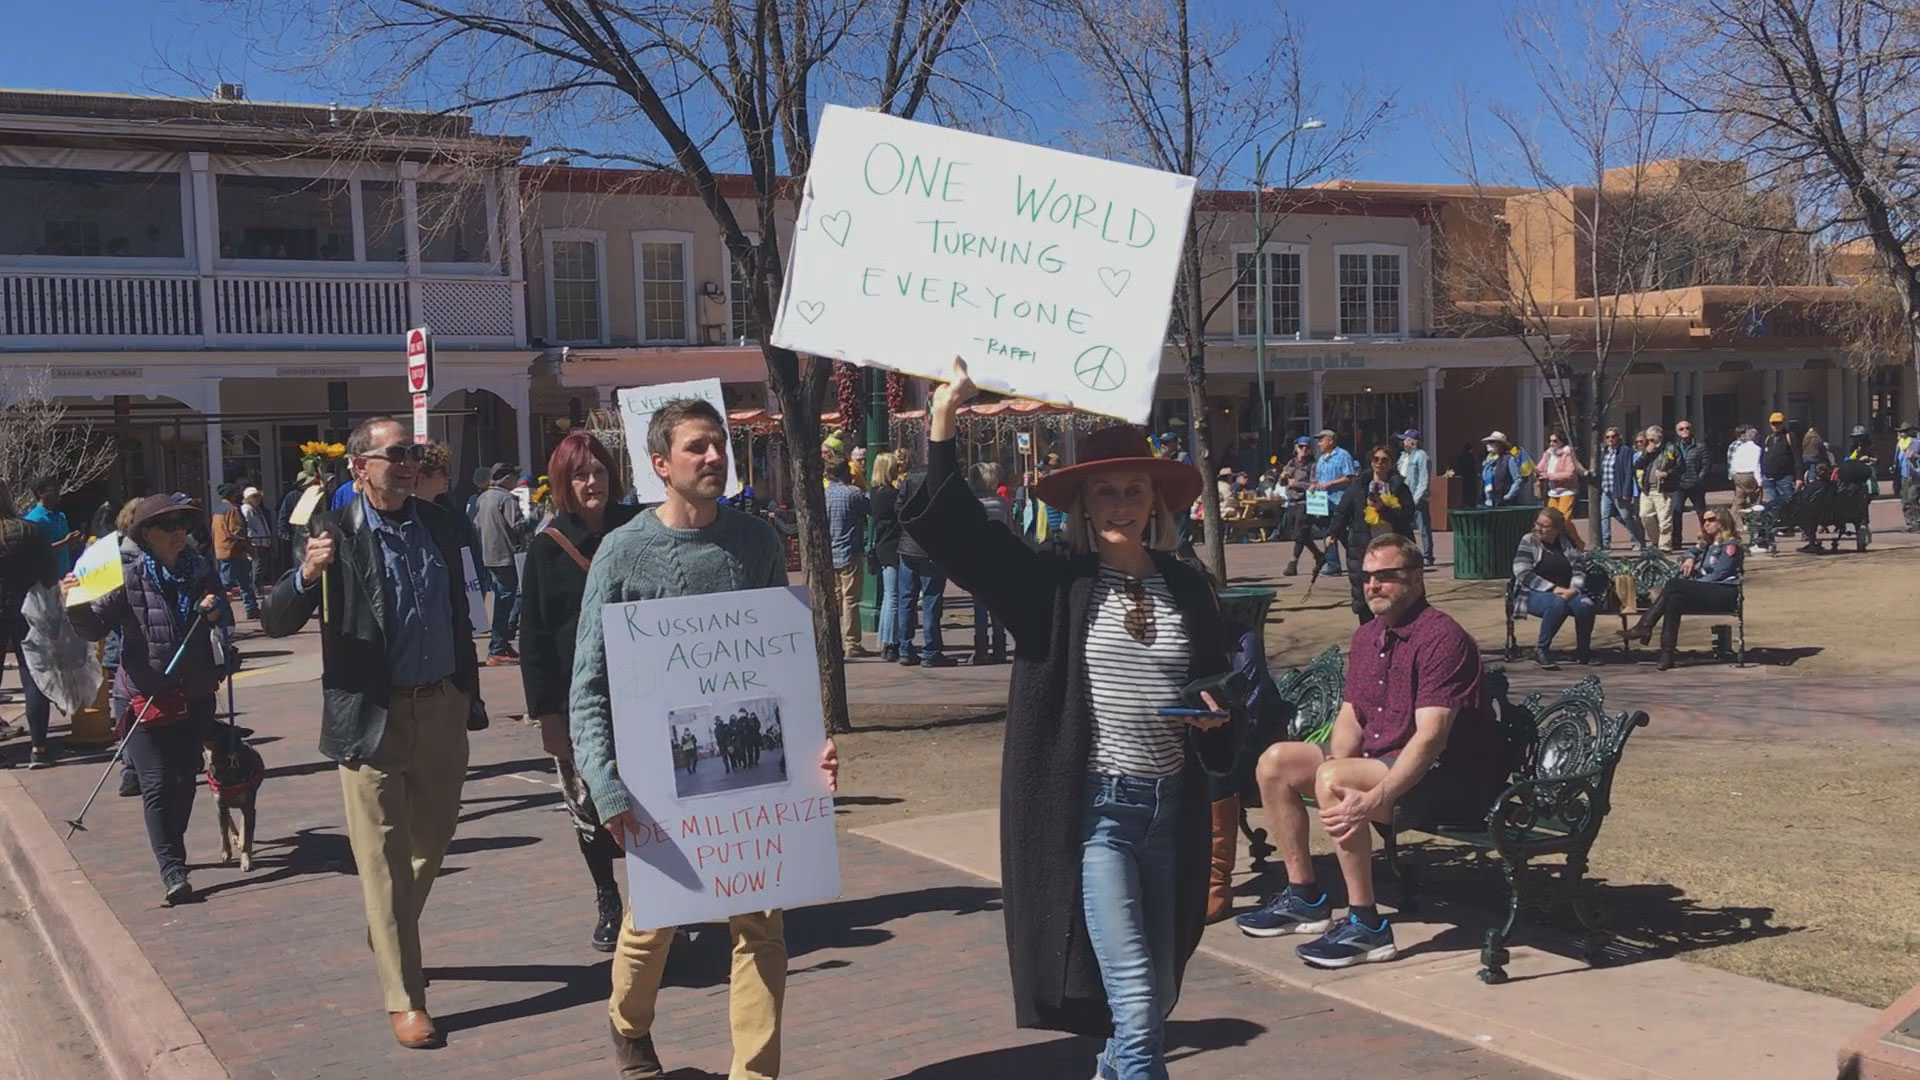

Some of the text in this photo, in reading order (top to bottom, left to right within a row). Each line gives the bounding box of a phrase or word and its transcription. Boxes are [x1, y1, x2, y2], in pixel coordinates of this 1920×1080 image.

[863, 142, 1155, 249] ONE WORLD
[915, 219, 1067, 274] TURNING
[862, 267, 1092, 335] EVERYONE
[624, 604, 758, 642] RUSSIANS
[666, 631, 804, 672] AGAINST
[698, 671, 768, 696] WAR
[696, 833, 782, 869] PUTIN
[714, 861, 783, 898] NOW!
